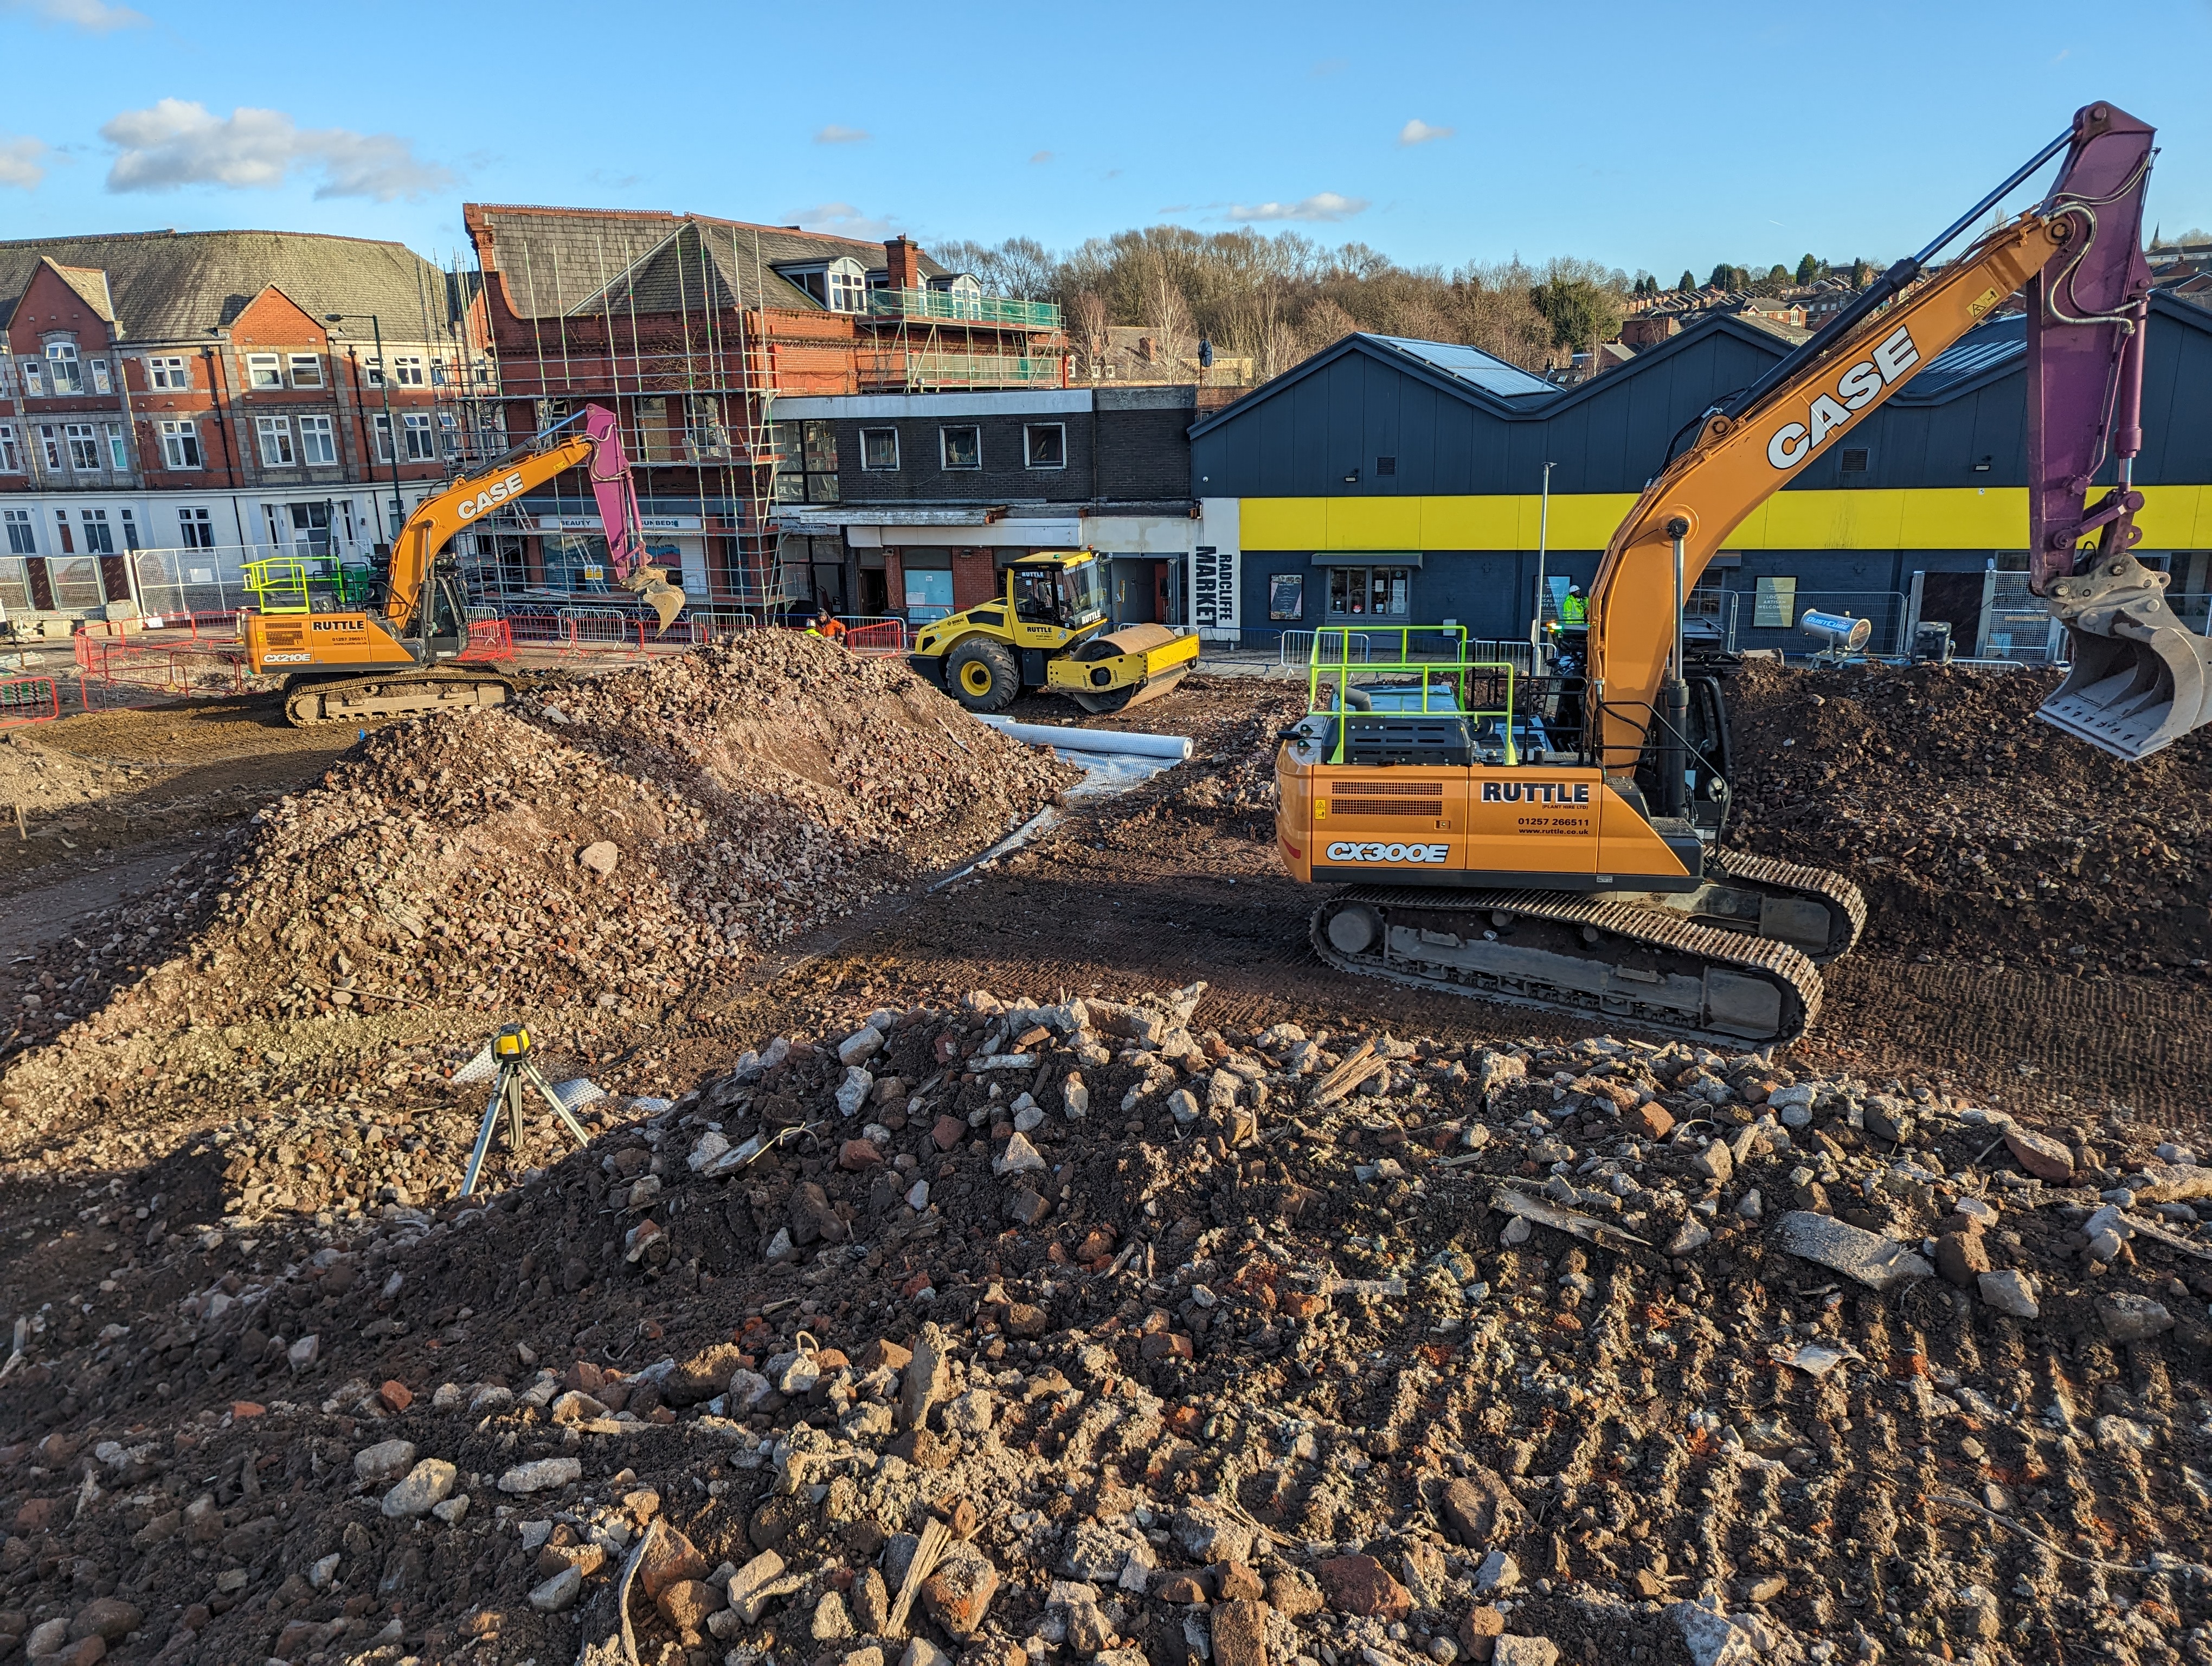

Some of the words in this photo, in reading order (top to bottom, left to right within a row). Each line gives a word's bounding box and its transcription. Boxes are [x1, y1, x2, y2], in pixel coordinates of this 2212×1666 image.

[1767, 324, 1921, 470] CASE
[458, 471, 524, 520] CASE
[1196, 546, 1217, 627] MARKET
[1219, 554, 1232, 620] RADCLIFFE
[312, 620, 364, 631] RUTTLE
[1082, 609, 1101, 625] RUTTLE
[262, 652, 311, 663] CX210E
[1481, 783, 1589, 803] RUTTLE
[1326, 842, 1450, 863] CX300E
